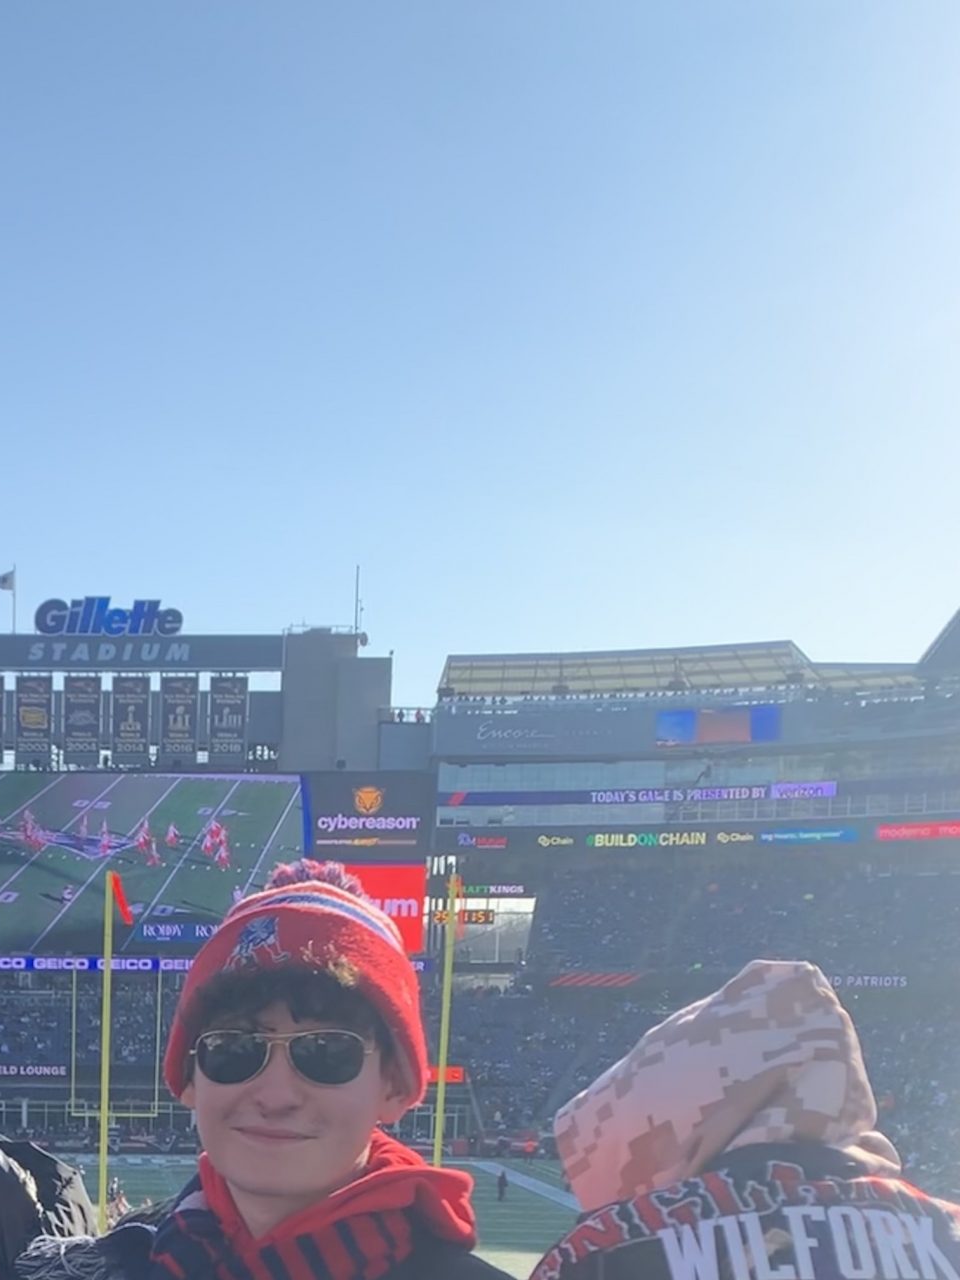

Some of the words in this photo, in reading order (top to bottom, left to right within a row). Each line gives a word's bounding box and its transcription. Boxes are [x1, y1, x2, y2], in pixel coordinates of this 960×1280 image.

[34, 596, 183, 637] Gillette
[28, 643, 190, 661] STADIUM
[687, 788, 749, 800] PRESENTED
[752, 787, 767, 798] BY
[317, 814, 418, 832] cybereason
[551, 836, 574, 846] Chain
[730, 833, 754, 843] Chain
[33, 957, 89, 969] GEICO
[846, 975, 908, 988] PATRIOTS
[20, 1065, 66, 1076] LOUNGE
